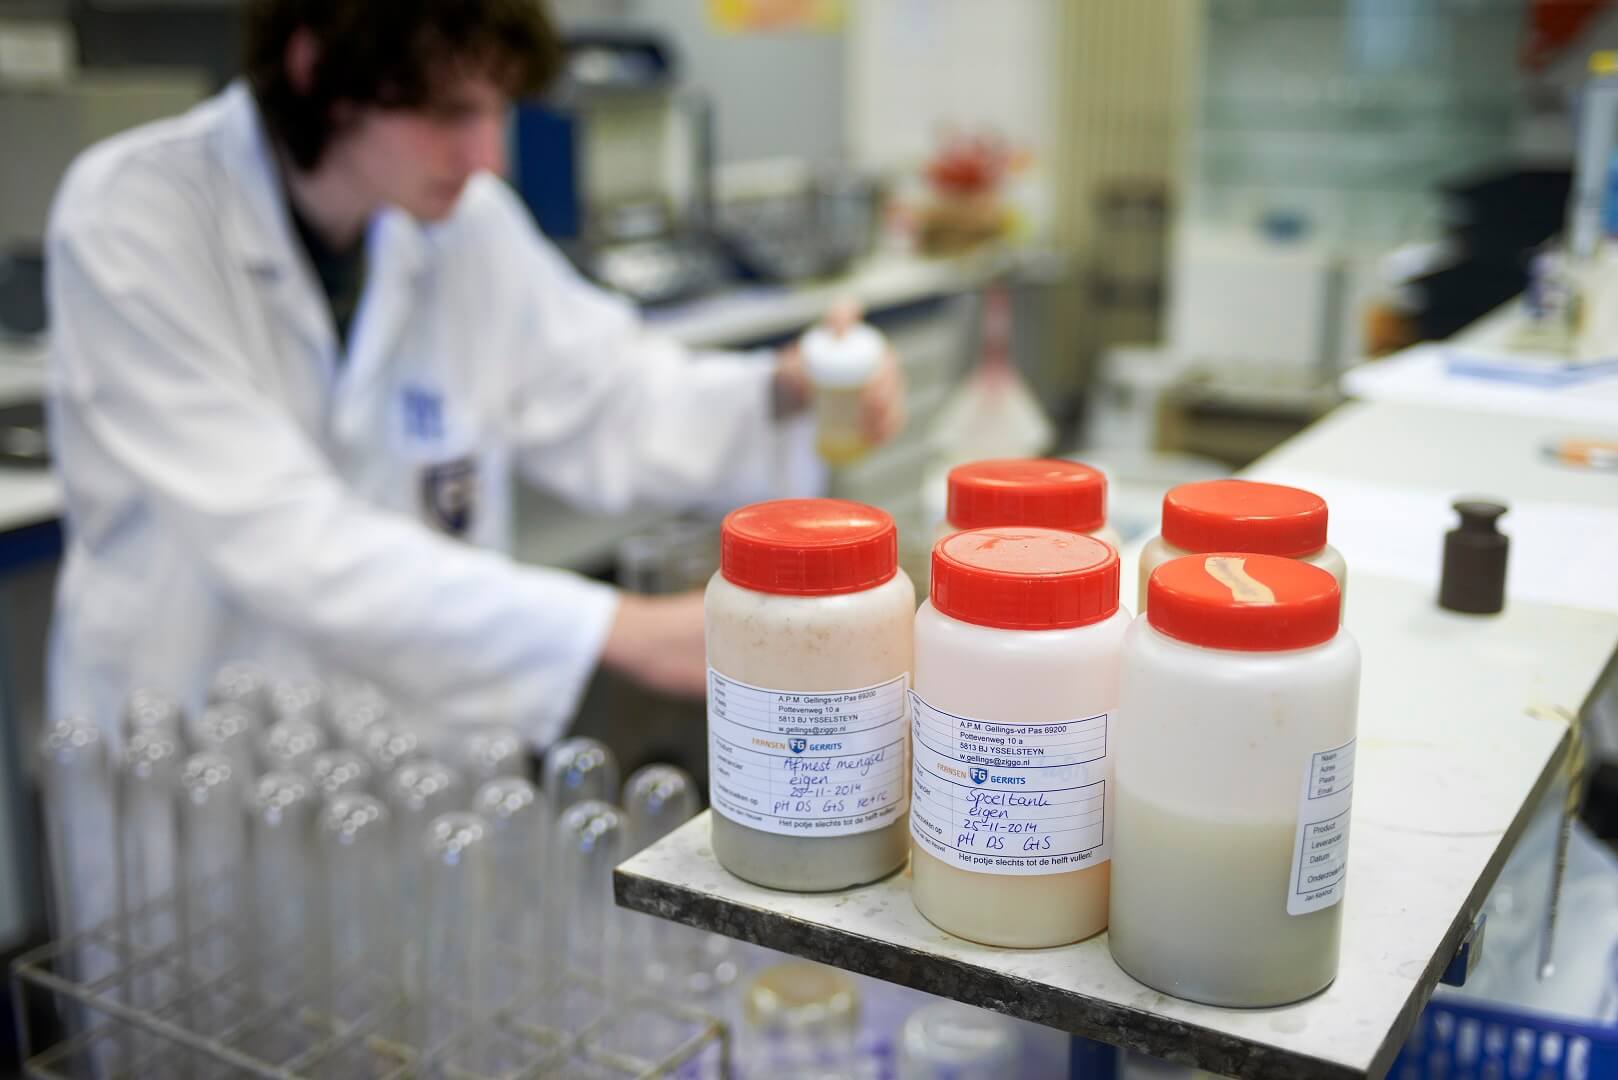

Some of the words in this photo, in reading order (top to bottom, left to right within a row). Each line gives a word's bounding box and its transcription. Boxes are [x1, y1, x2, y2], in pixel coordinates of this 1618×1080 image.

[778, 695, 801, 704] A.P.M.
[803, 696, 842, 705] Gellings-vd
[844, 694, 857, 703] Pas
[778, 706, 823, 714] Pottevenweg
[778, 715, 796, 723] 5813
[809, 714, 858, 723] YSSELSTEYN
[959, 721, 983, 731] A.P.M.
[985, 725, 1026, 735] Gellings-vd
[1044, 725, 1067, 734] 69200
[752, 737, 786, 750] FRANSEN
[790, 740, 805, 750] FG
[809, 742, 843, 751] GERRITS
[959, 732, 1005, 745] Pottevenweg
[1007, 737, 1017, 745] 10
[959, 743, 976, 751] 5813
[978, 745, 988, 753] BJ
[990, 746, 1044, 756] YSSELSTEYN
[959, 754, 1030, 767] w.gellings@ziggo.nl
[936, 762, 967, 779] FRANSEN
[971, 769, 987, 781] FG
[990, 775, 1026, 784] GERRITS
[789, 775, 829, 789] eigen
[795, 801, 812, 812] DS
[969, 806, 1009, 823] eigen
[778, 819, 793, 827] Het
[794, 820, 813, 829] potje
[815, 820, 842, 828] slechts
[843, 818, 853, 826] tot
[963, 818, 1037, 833] 25-11-2014
[1313, 821, 1336, 835] Product
[957, 832, 974, 848] pH
[986, 835, 1005, 849] DS
[958, 852, 972, 863] Het
[973, 855, 993, 866] potje
[995, 857, 1024, 867] slechts
[1026, 858, 1037, 866] tot
[1038, 857, 1050, 866] de
[1051, 855, 1069, 865] helft
[1070, 851, 1093, 863] vullen!
[1309, 852, 1330, 865] Datum
